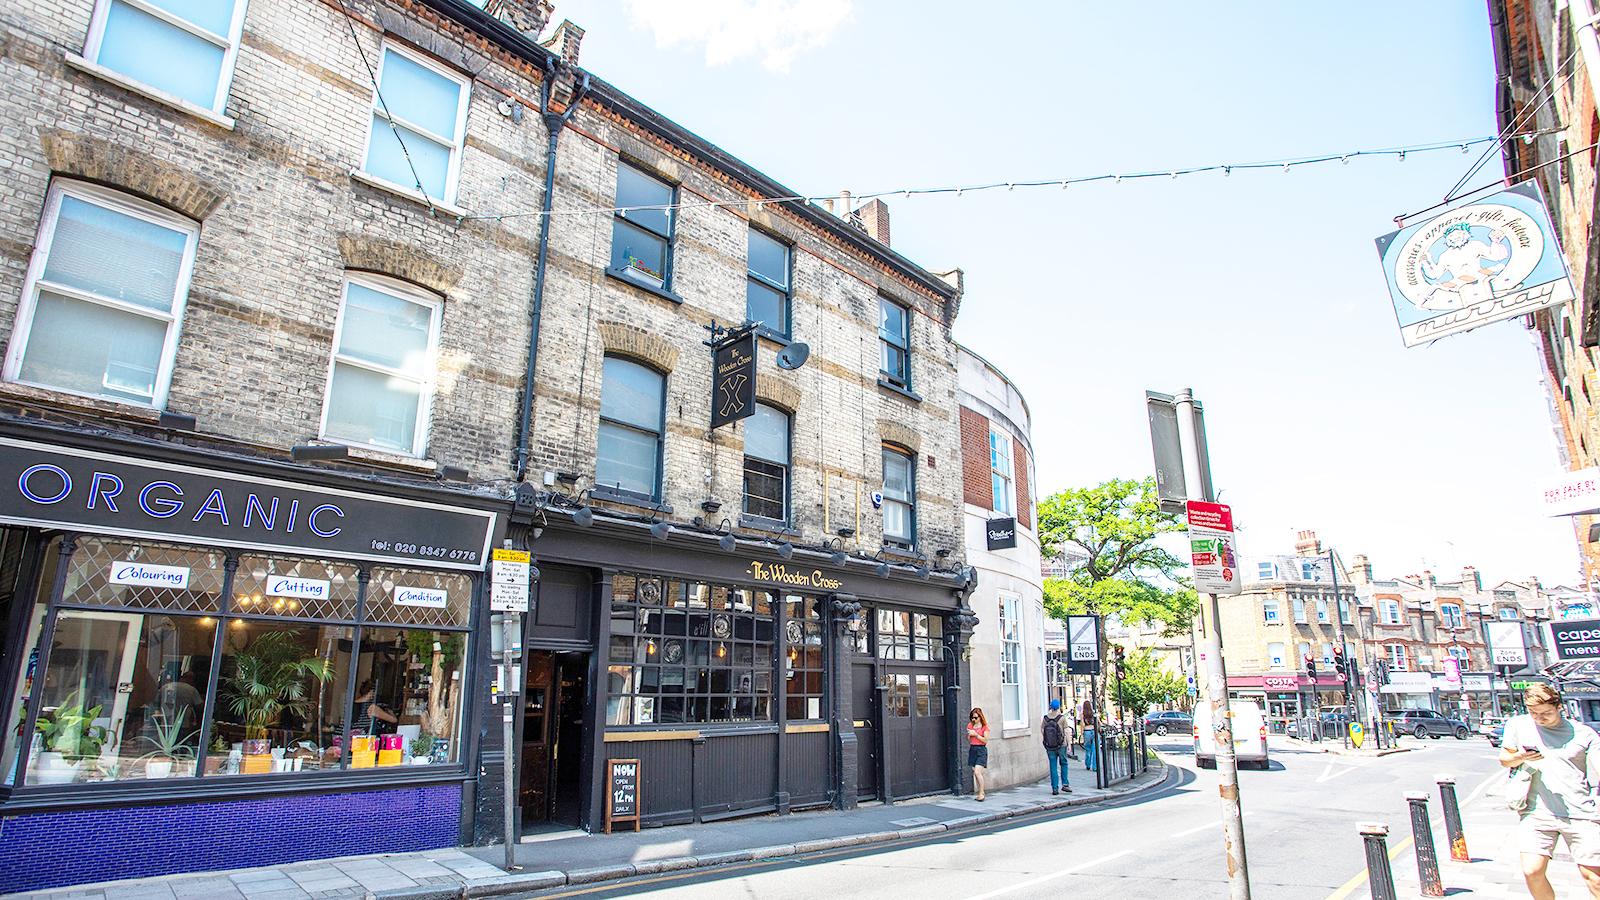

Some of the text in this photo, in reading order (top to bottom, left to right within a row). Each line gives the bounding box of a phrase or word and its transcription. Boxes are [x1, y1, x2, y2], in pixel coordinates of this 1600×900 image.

[1425, 212, 1473, 240] apparel
[1479, 209, 1504, 222] gifts
[1415, 283, 1556, 335] murray
[718, 355, 752, 374] Wooden Cross
[18, 463, 345, 538] ORGANIC
[371, 540, 391, 551] tel:
[394, 542, 417, 554] 020
[419, 545, 447, 558] 8347
[116, 566, 184, 584] Colouring
[769, 563, 810, 586] Wooden
[274, 580, 322, 596] Cutting
[398, 591, 442, 602] Condition
[1565, 646, 1600, 655] mens
[614, 764, 636, 776] NOW
[614, 790, 634, 803] 12 PM
